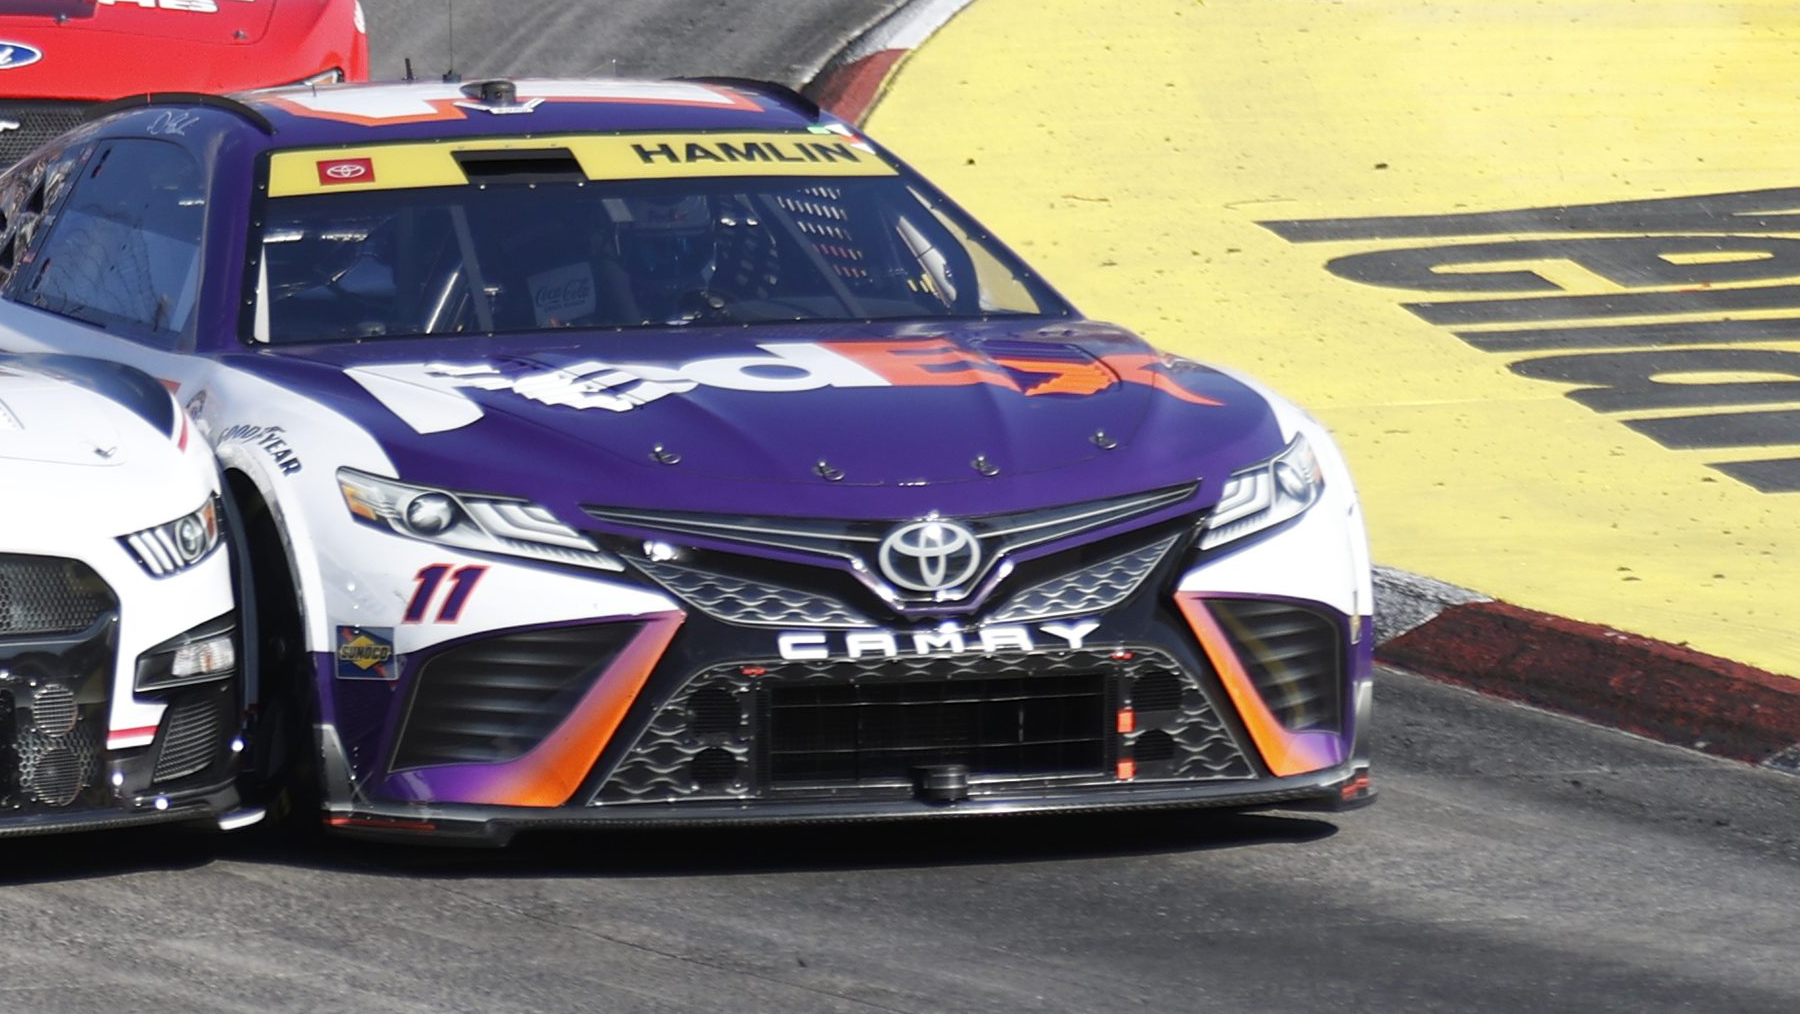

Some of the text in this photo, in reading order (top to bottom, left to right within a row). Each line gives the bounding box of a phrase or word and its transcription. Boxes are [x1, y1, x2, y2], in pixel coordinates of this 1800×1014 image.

[630, 139, 862, 165] HAMLIN
[402, 563, 491, 625] 11
[339, 642, 392, 661] SUNOCO
